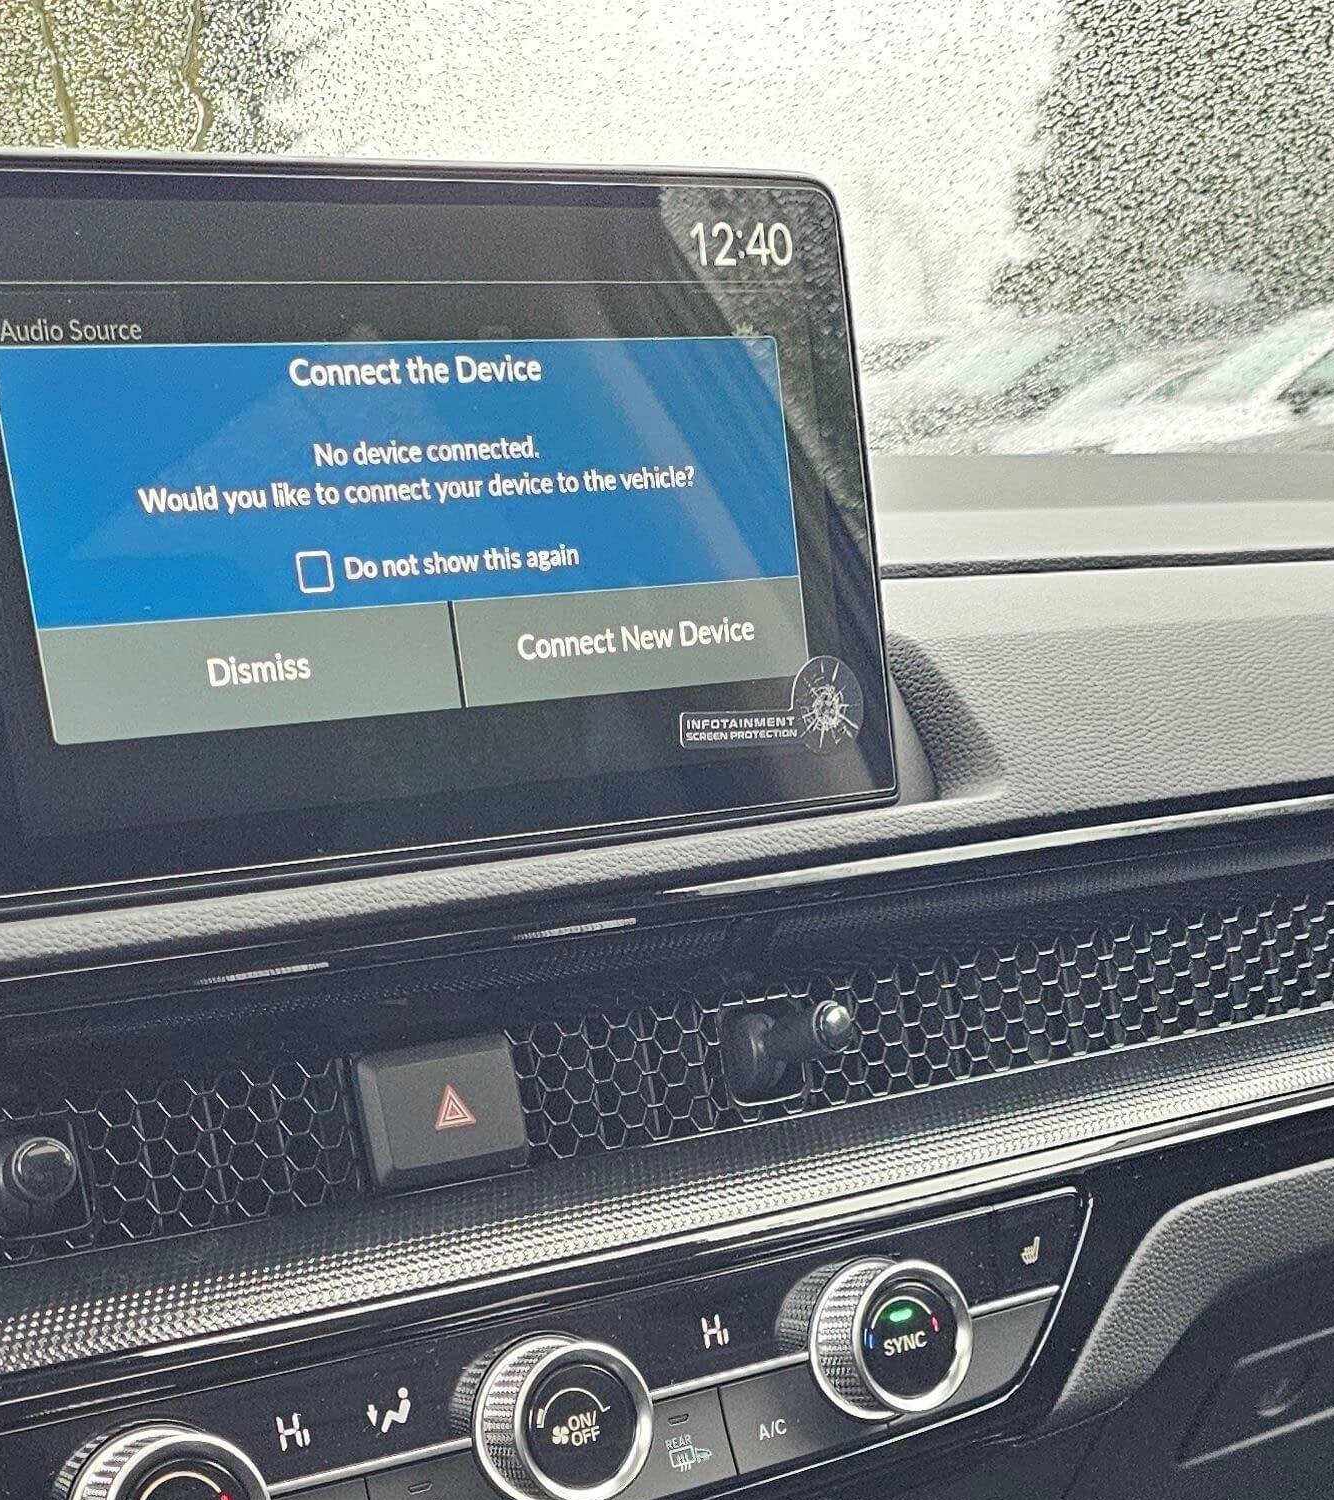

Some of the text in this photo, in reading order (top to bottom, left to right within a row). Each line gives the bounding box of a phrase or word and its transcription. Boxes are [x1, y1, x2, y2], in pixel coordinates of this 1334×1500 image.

[689, 221, 793, 266] 12:40
[0, 318, 142, 342] Audio Source
[288, 354, 542, 387] Connect the Device
[313, 435, 540, 467] No device connected.
[137, 465, 695, 515] Would you like to connect your device to the vehicle?
[343, 543, 580, 580] Do not show this again
[517, 616, 755, 660] Connect New Device
[206, 652, 311, 687] Dismiss
[685, 728, 798, 742] SCREEN PROTECTION
[686, 715, 795, 730] INFOTAINMENT
[883, 1330, 929, 1357] SYNC
[567, 1410, 598, 1431] ON/
[758, 1418, 788, 1441] A/C
[571, 1425, 601, 1447] OFF
[665, 1434, 693, 1451] REAR
